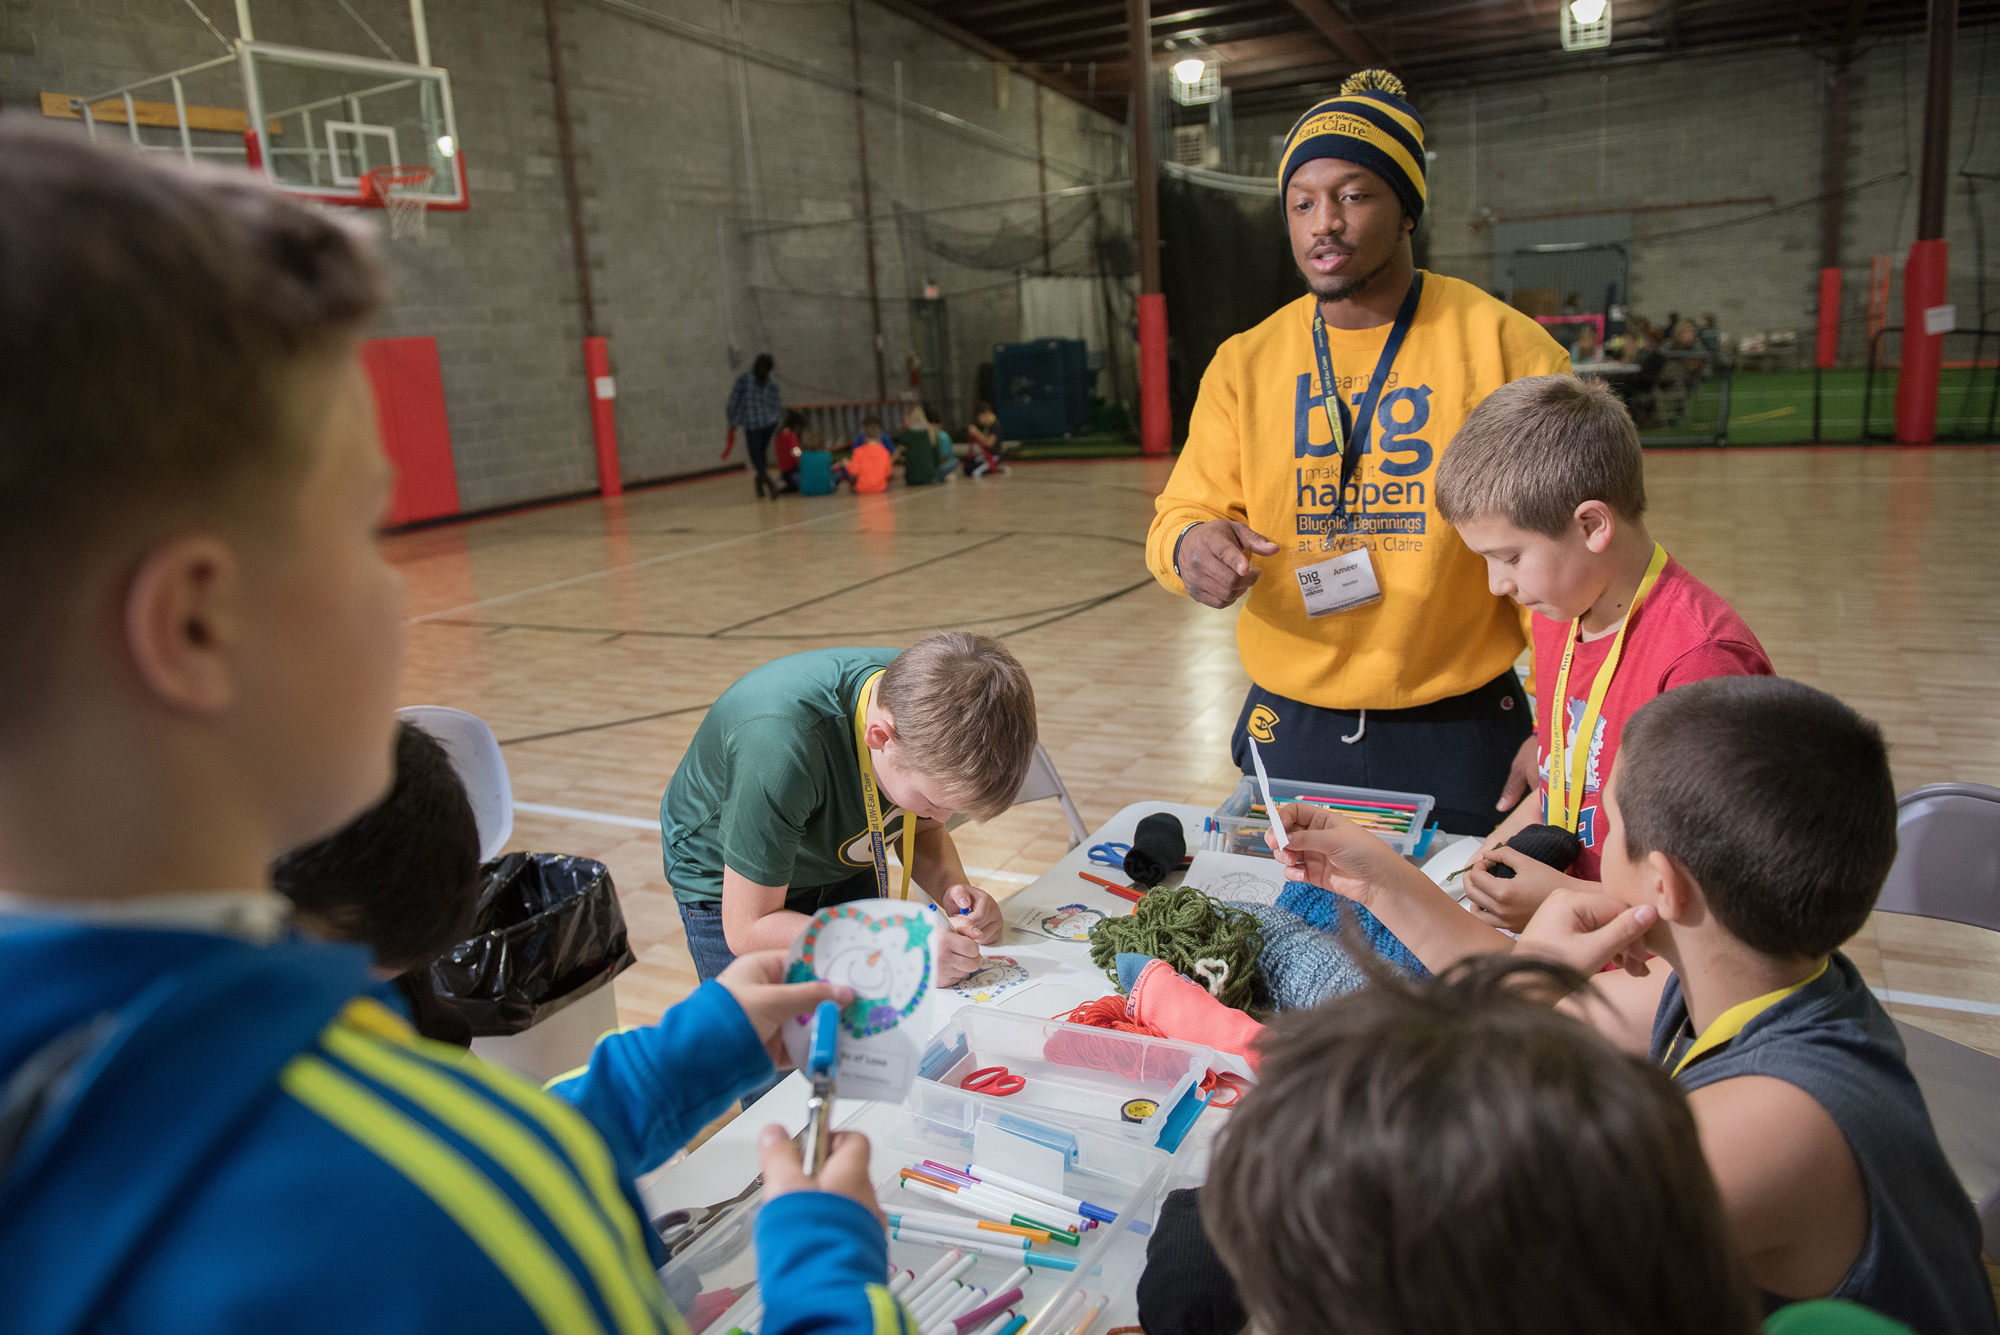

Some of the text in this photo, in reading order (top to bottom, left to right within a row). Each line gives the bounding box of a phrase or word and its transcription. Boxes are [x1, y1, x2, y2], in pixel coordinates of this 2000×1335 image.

[1299, 119, 1367, 138] Eau Claire
[1335, 114, 1371, 129] Wisconsin
[1305, 462, 1375, 481] makg it
[1296, 467, 1425, 513] happen
[1299, 514, 1422, 534] Blugold Beginnings
[1298, 536, 1423, 552] at UW-Eau Claire
[1298, 570, 1321, 586] big
[1333, 563, 1358, 576] Ameer
[1561, 653, 1571, 671] big
[864, 772, 873, 792] Claire
[1552, 769, 1561, 790] Claire
[867, 793, 878, 822] UW-Eau
[873, 832, 885, 872] Beginnings
[879, 872, 889, 898] uegold
